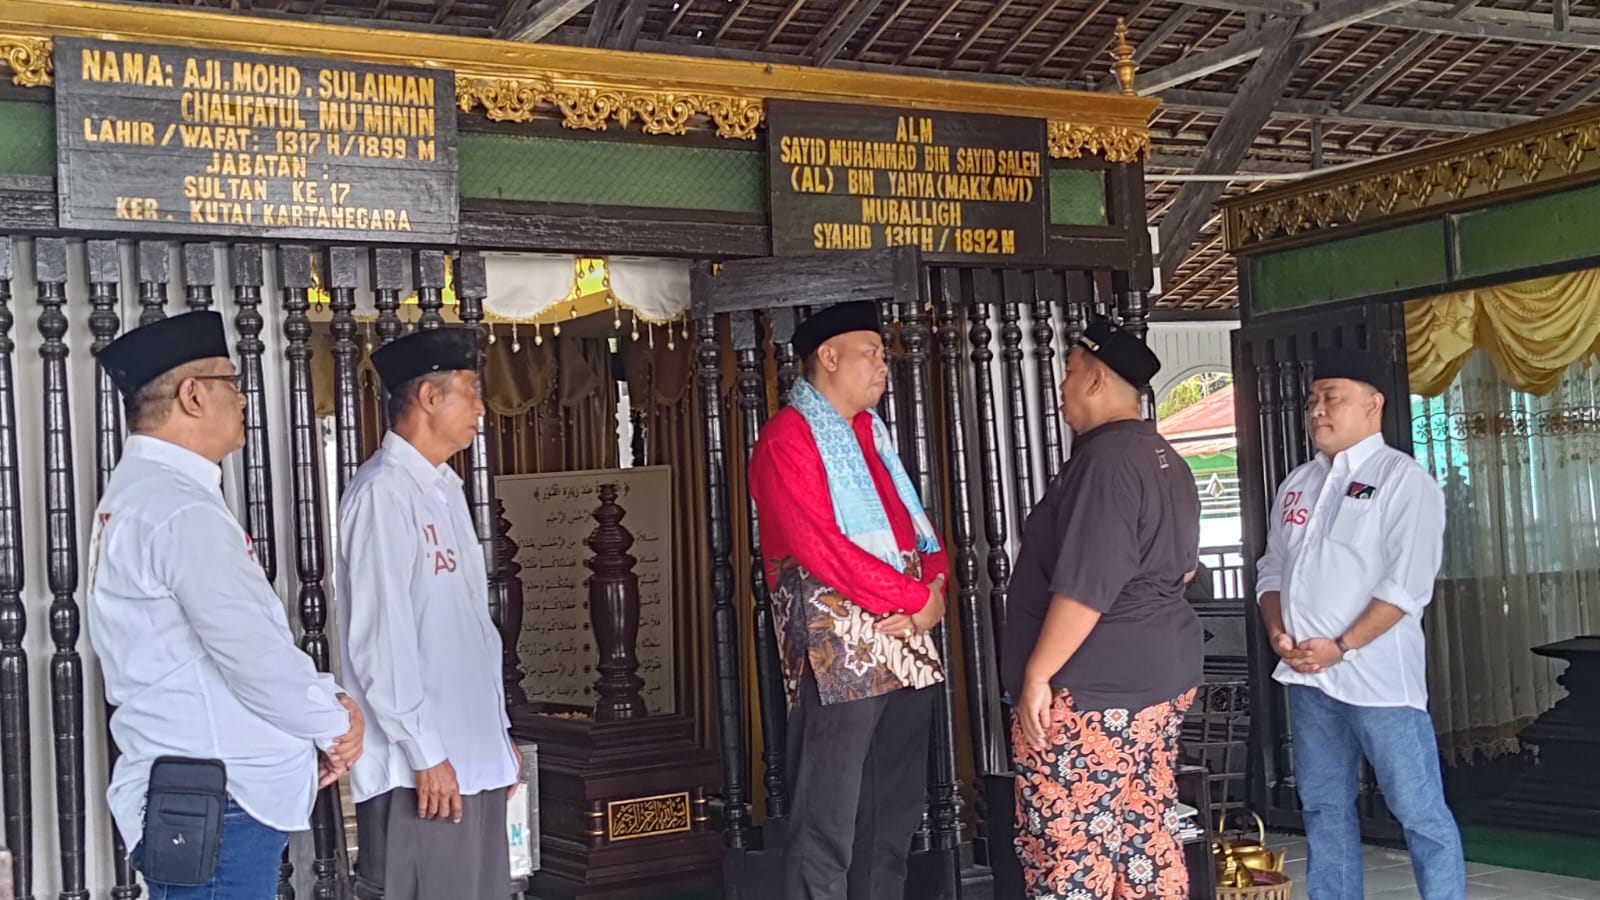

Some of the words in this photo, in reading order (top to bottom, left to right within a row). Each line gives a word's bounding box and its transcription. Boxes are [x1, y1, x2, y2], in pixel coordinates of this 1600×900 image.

[81, 48, 173, 88] NAMA:
[319, 69, 434, 107] SULAIMAN
[181, 92, 306, 129] CHALIFATUL
[275, 131, 321, 156] 1317
[896, 115, 934, 144] ALM
[206, 152, 306, 178] JABATAN
[780, 136, 826, 165] SAYID
[829, 139, 917, 170] MUHAMMAD
[924, 146, 950, 173] BIN
[956, 147, 995, 175] SAYID
[998, 150, 1041, 178] SALEH
[184, 175, 267, 200] SULTAN
[790, 166, 834, 193] (AL)
[848, 169, 874, 195] BIN
[190, 200, 252, 225] KUTAI
[263, 203, 412, 232] KARTANEGARA
[861, 198, 962, 227] MUBALLIGH
[812, 223, 872, 250] SYAHID
